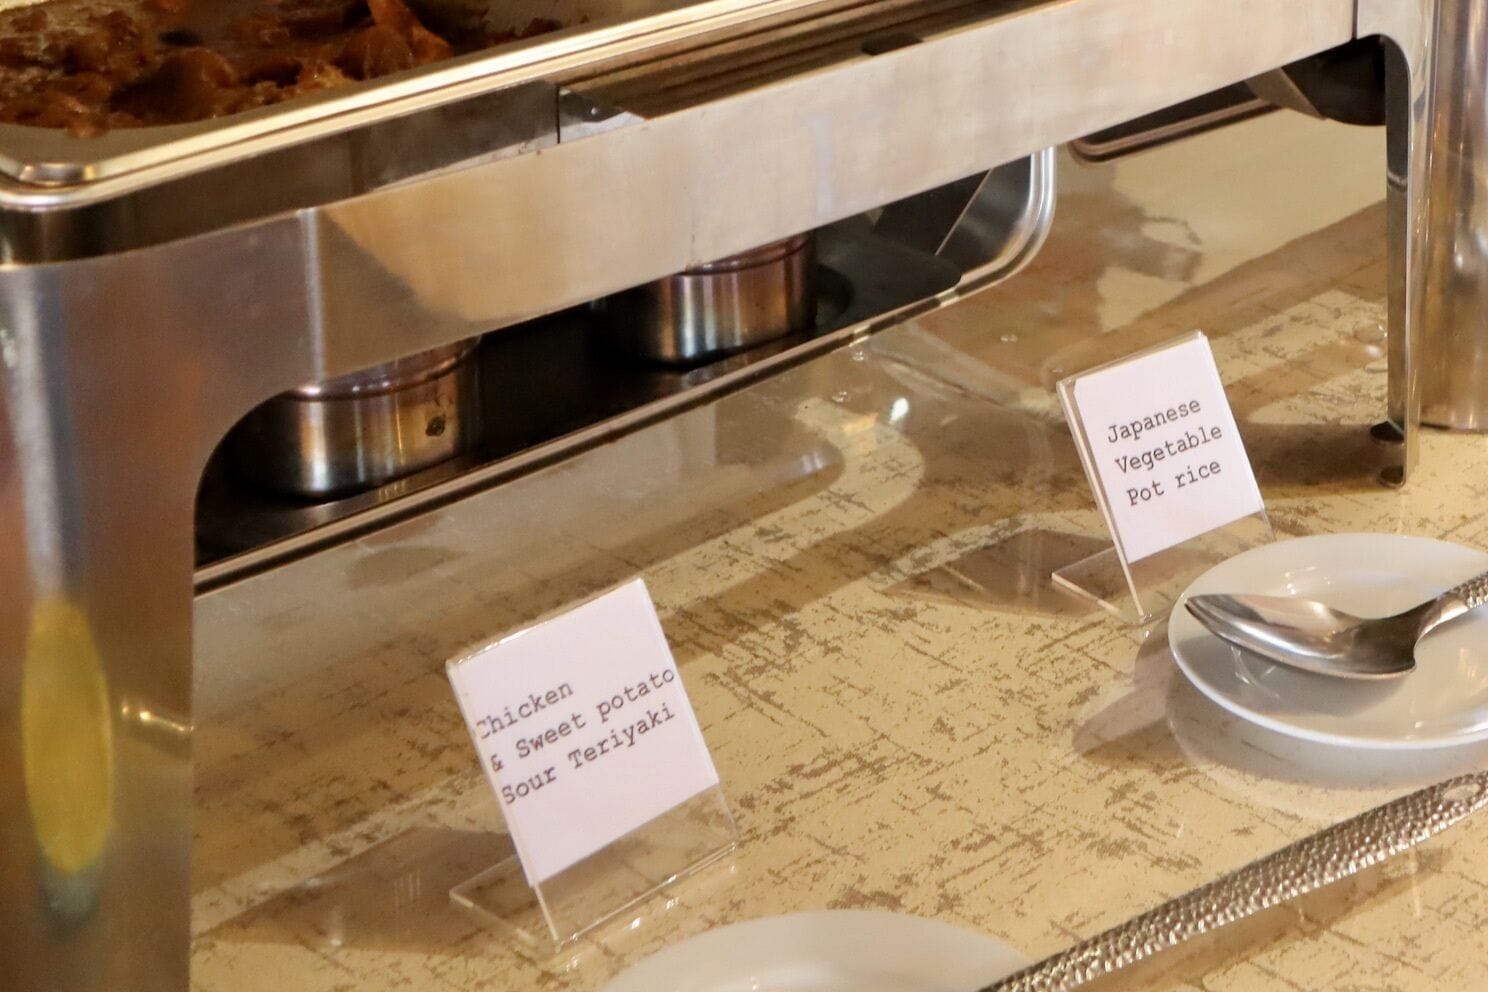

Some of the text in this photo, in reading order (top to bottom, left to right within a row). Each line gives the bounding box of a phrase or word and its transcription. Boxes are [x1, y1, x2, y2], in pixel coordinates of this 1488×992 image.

[1107, 399, 1202, 443] Japanese
[1114, 425, 1223, 474] Vegetable
[1126, 460, 1222, 506] Pot rice
[490, 669, 675, 772] & Sweet potato
[501, 702, 675, 805] Sour Teriyaki
